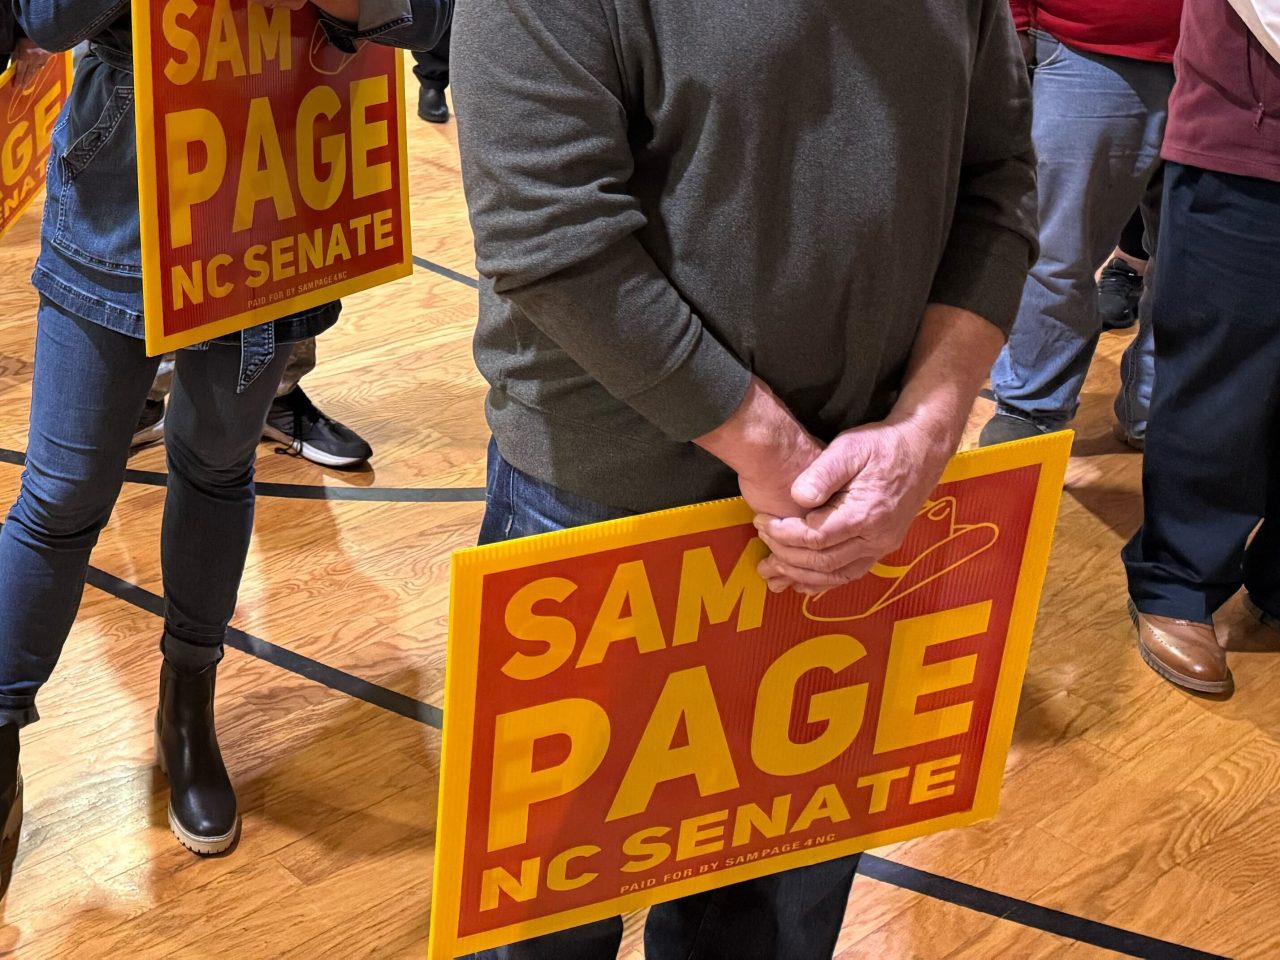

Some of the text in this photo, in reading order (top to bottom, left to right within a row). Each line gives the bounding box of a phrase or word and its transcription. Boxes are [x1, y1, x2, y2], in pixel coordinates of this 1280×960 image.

[165, 74, 392, 249] PAGE
[171, 208, 394, 311] NC SENATE
[247, 296, 266, 309] PAID
[269, 291, 285, 302] FOR
[286, 287, 296, 297] BY
[500, 536, 771, 680] SAM
[487, 601, 991, 853] PAGE
[479, 754, 962, 913] NC SENATE
[620, 878, 656, 894] PAID
[663, 868, 693, 882] FOR
[699, 861, 720, 875] BY
